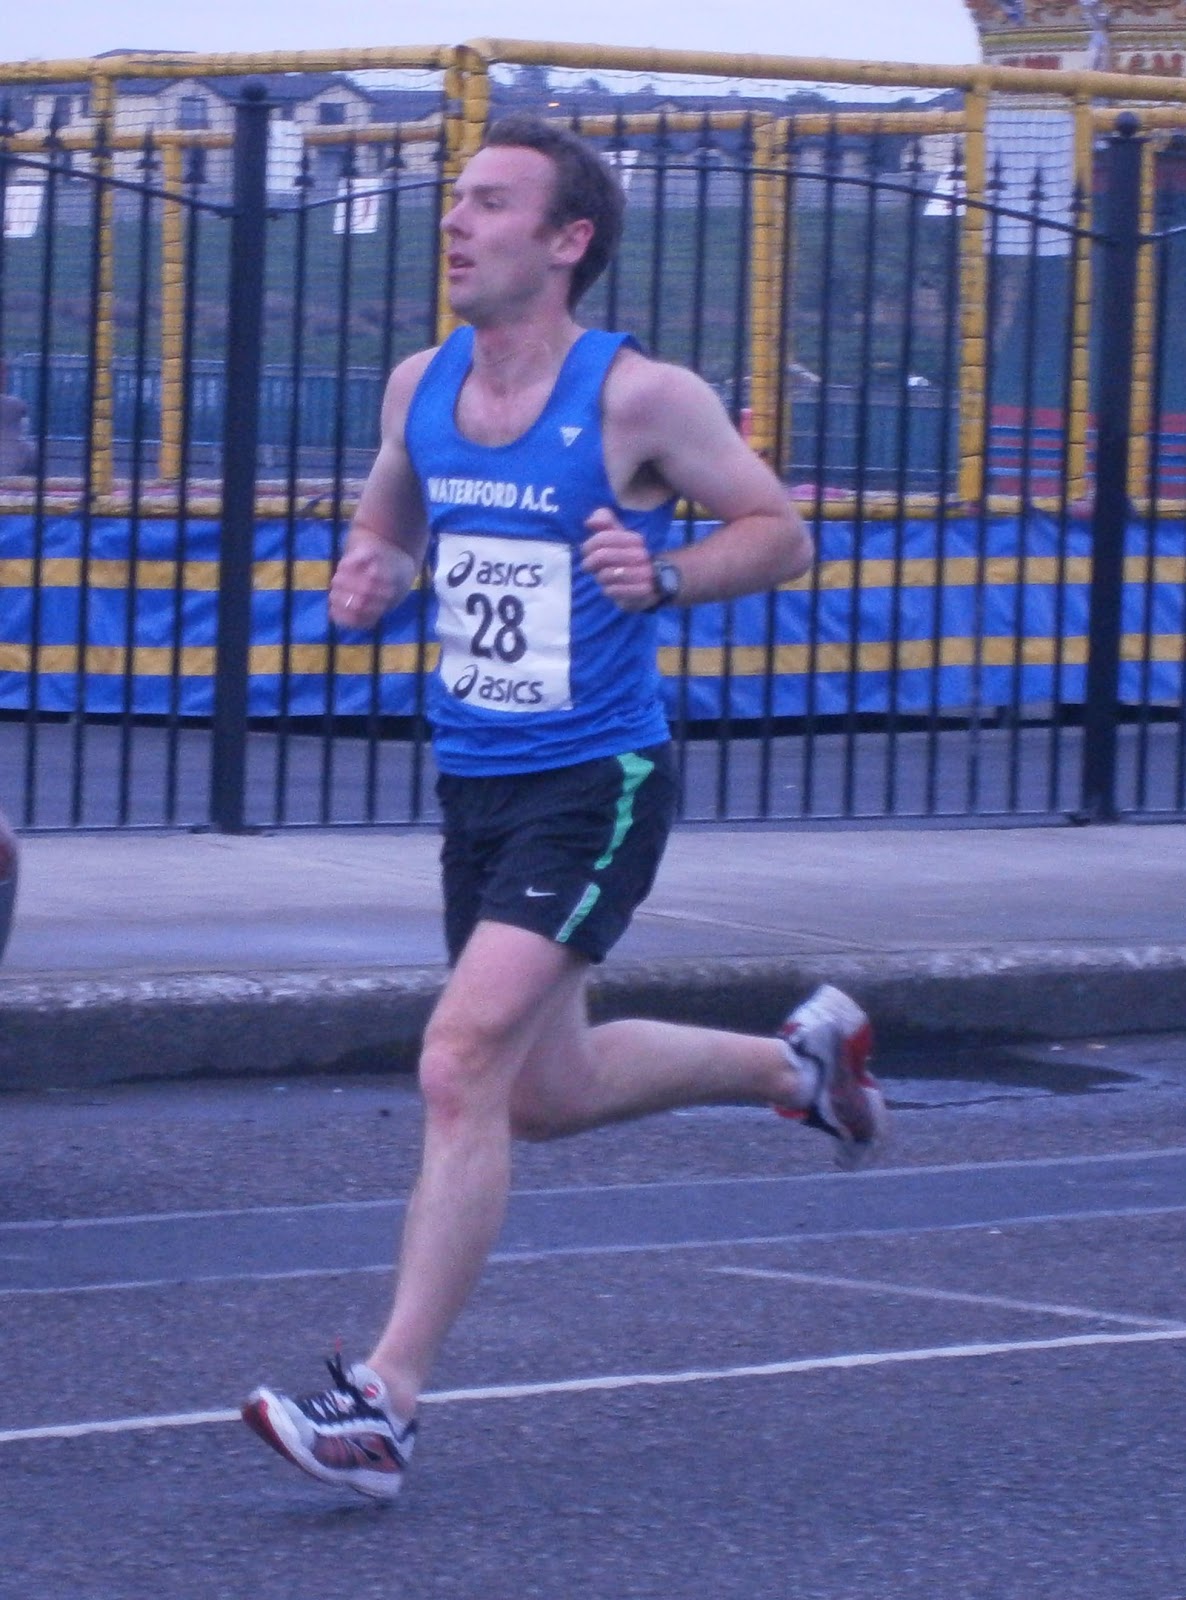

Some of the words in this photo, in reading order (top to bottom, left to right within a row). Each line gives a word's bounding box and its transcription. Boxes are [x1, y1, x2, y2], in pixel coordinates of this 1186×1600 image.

[427, 477, 518, 508] WATERFORD
[519, 485, 560, 513] A.C.
[465, 592, 527, 664] 28
